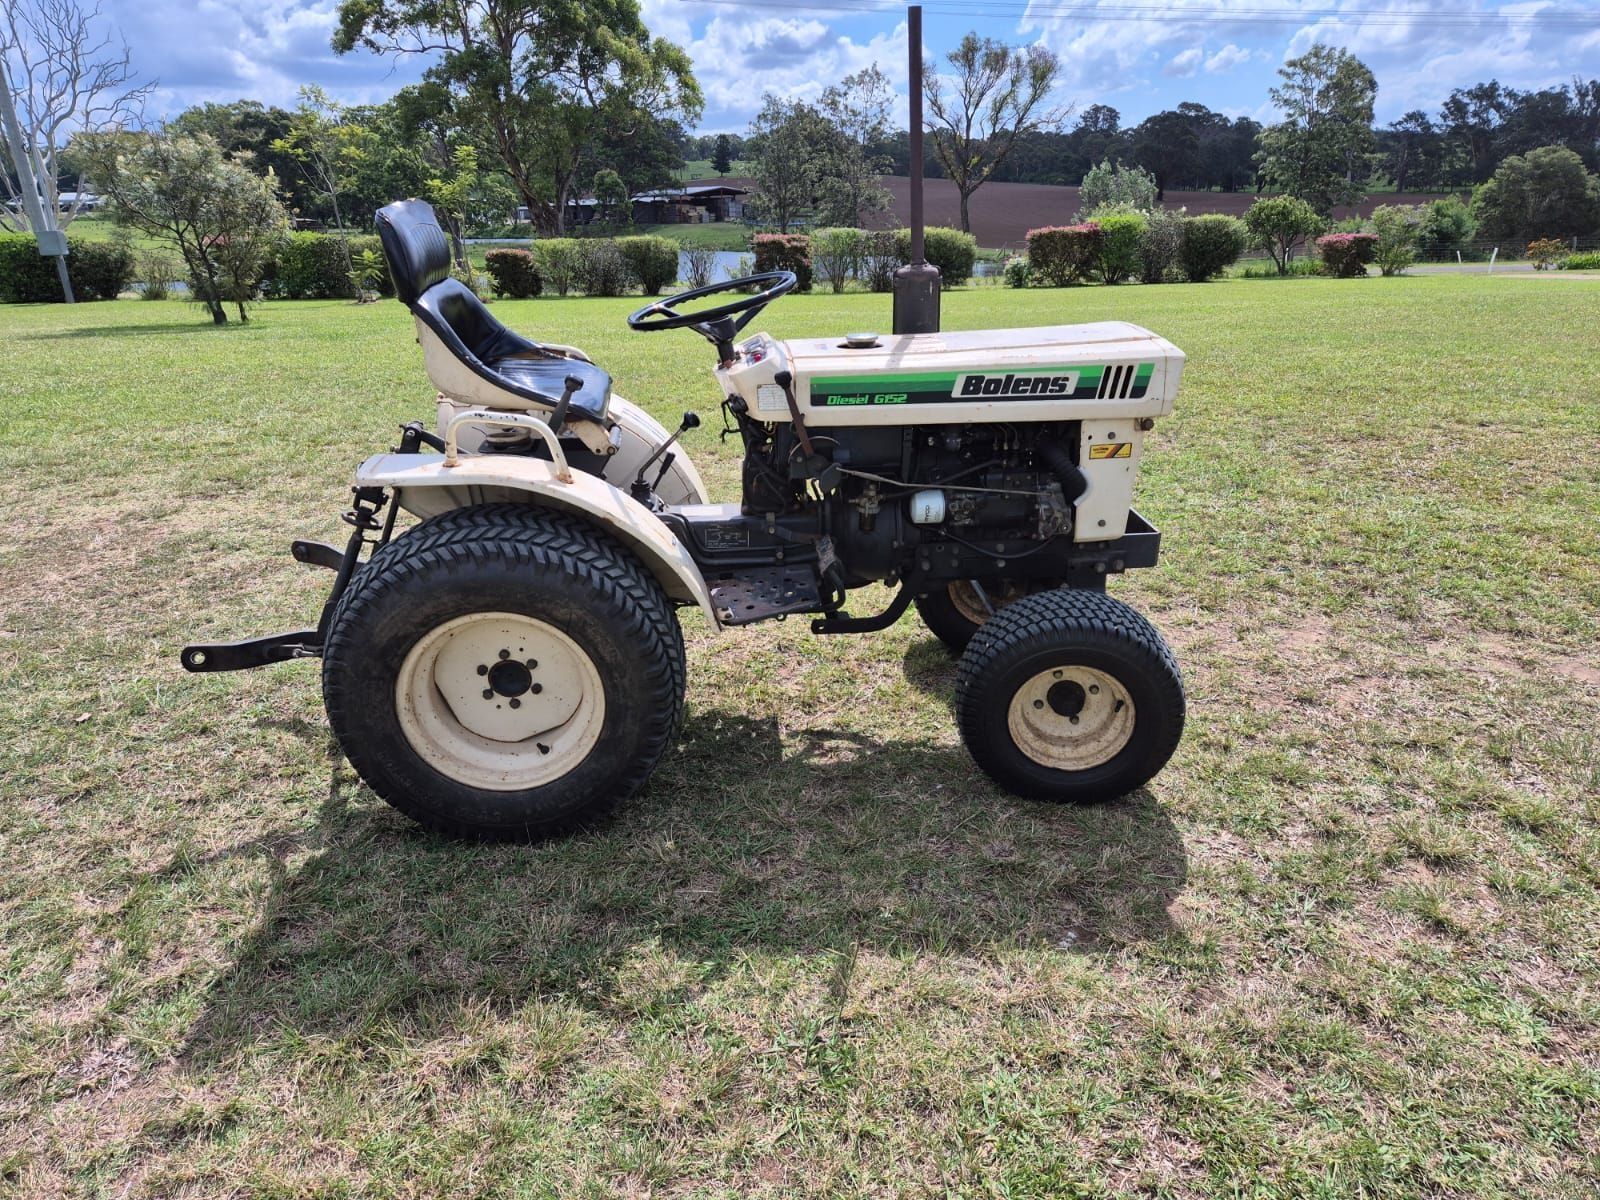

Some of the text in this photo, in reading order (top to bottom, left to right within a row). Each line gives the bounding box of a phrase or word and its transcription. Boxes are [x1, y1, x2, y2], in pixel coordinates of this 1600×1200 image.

[960, 374, 1070, 396] Bolens
[827, 393, 908, 405] Diesel G152
